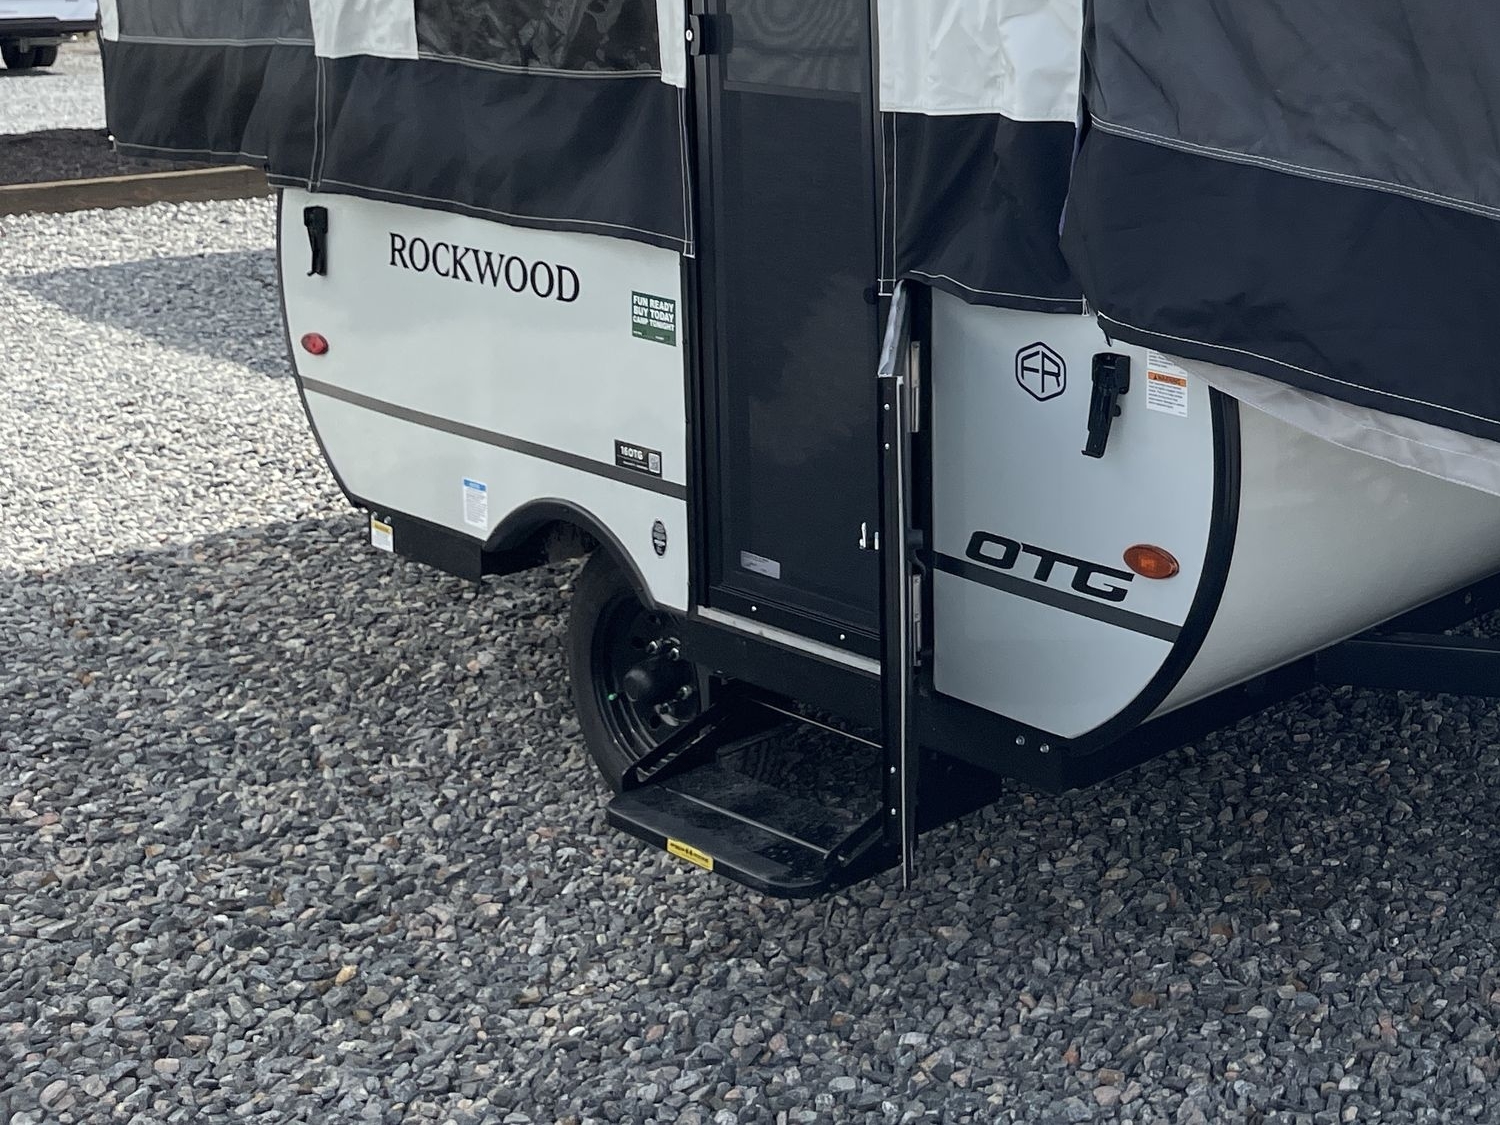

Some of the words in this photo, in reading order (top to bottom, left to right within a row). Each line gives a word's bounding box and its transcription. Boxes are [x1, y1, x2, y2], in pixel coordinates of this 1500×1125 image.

[389, 232, 581, 303] ROCKWOOD
[633, 295, 649, 307] FUN
[650, 298, 675, 313] READY
[633, 305, 649, 317] BUY
[650, 308, 675, 323] TODAY
[965, 531, 1135, 602] OTG
